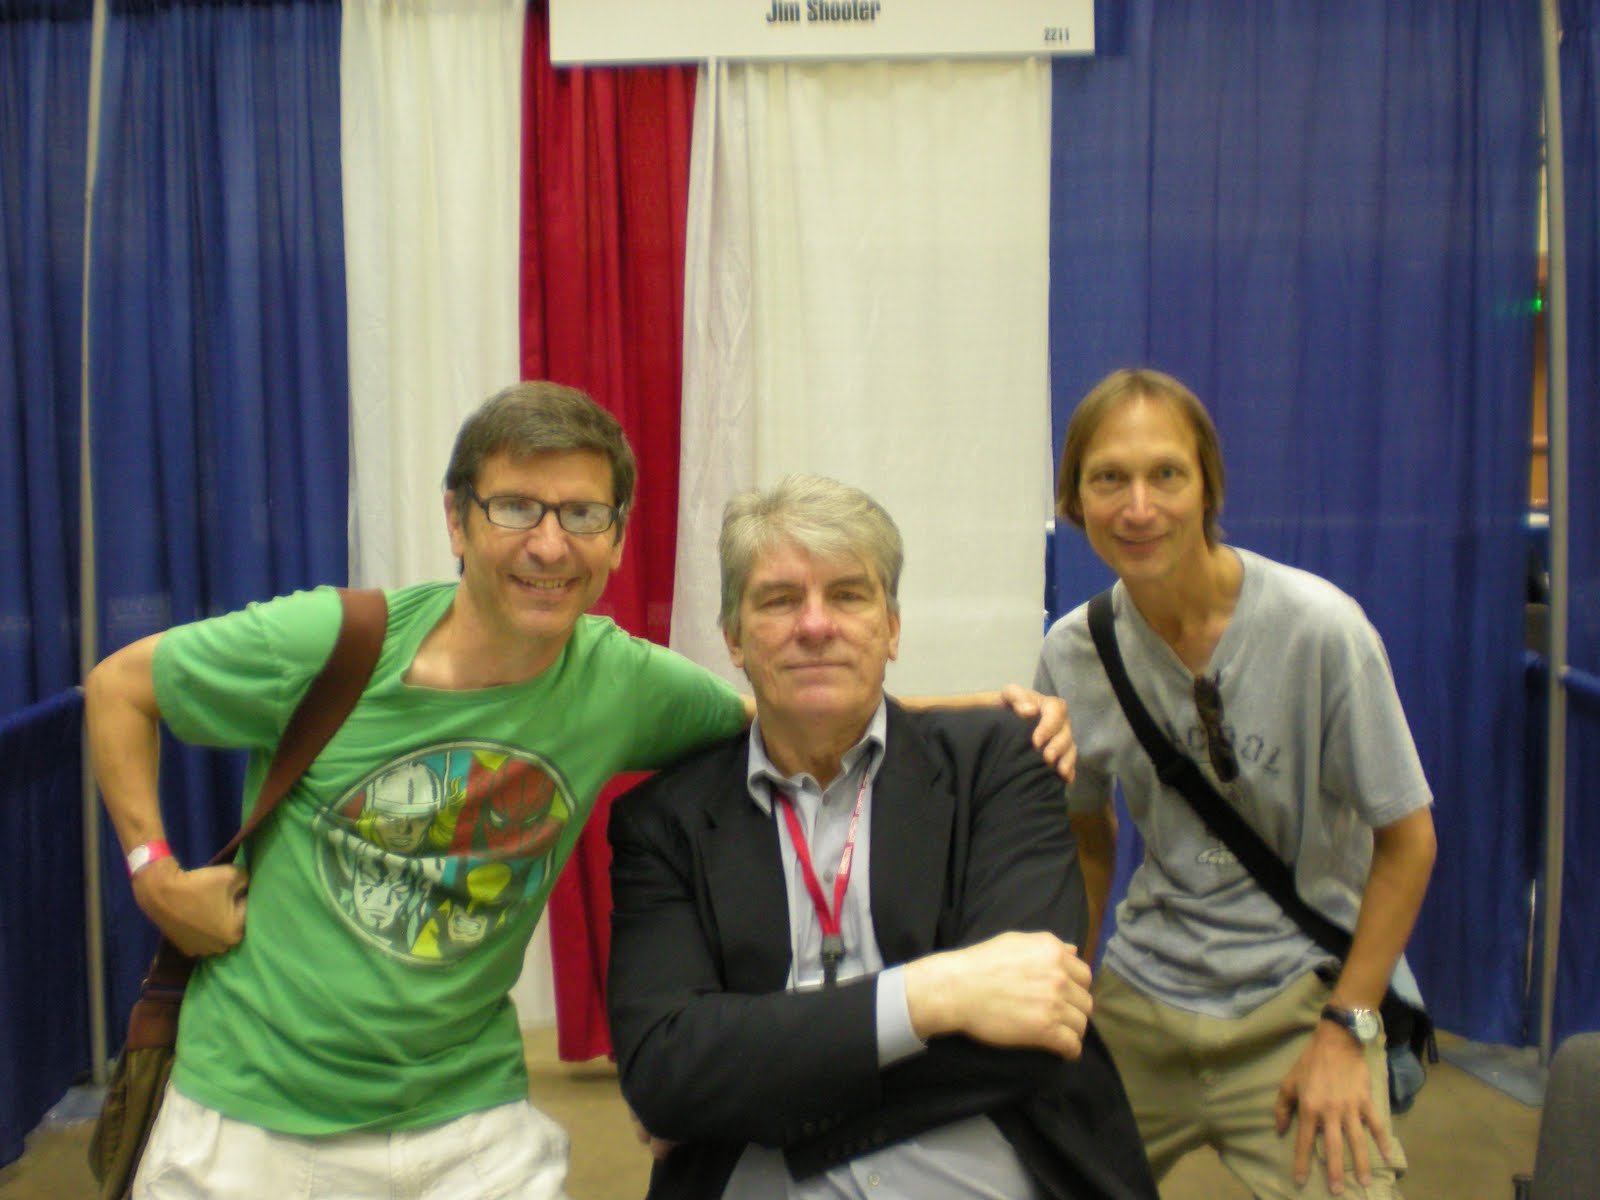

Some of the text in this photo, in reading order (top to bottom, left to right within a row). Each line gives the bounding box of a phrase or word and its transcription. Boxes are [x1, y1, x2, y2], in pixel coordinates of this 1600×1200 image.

[766, 0, 881, 24] Jim Shooter
[1043, 26, 1070, 42] 2211
